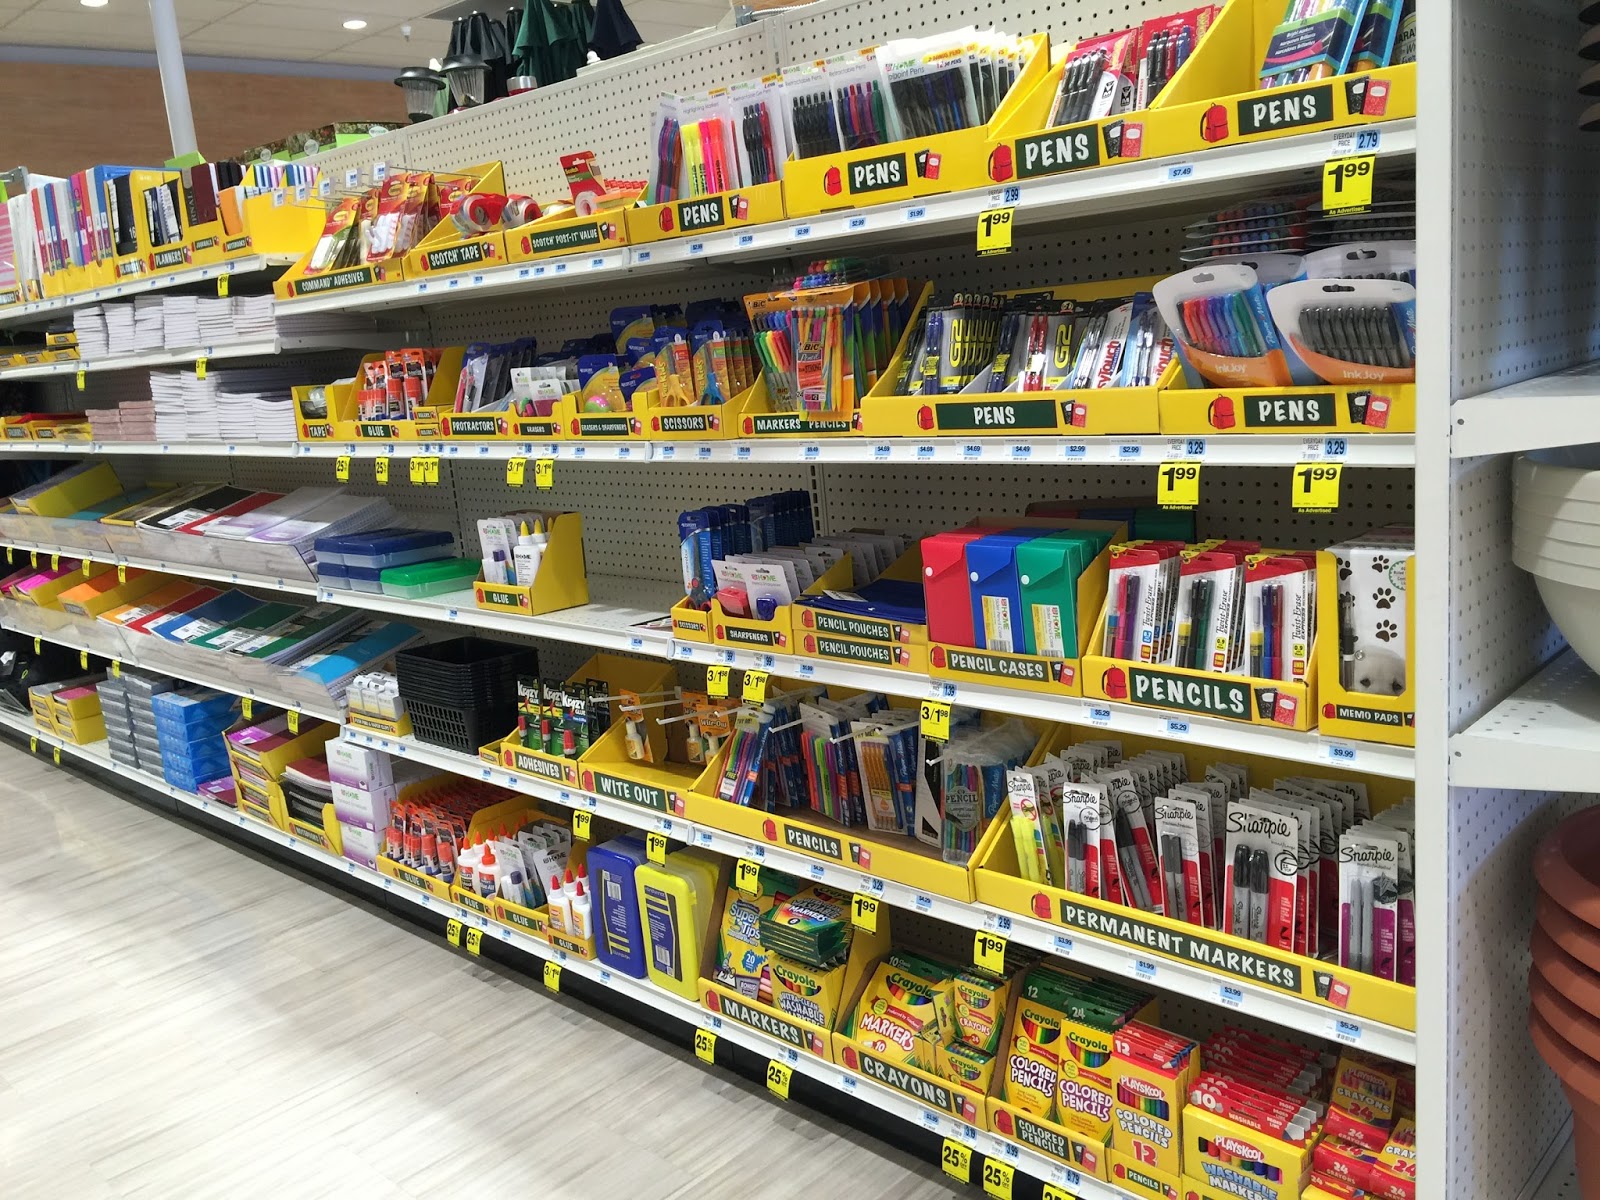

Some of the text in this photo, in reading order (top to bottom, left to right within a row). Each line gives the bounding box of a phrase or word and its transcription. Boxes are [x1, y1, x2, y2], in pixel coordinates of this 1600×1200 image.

[1253, 94, 1317, 128] PENS
[1358, 132, 1378, 149] 2.79
[1024, 134, 1089, 170] PENS
[854, 160, 900, 188] PENS
[1172, 168, 1192, 176] $7.49
[1005, 188, 1019, 202] 2.99
[682, 202, 720, 226] PENS
[579, 228, 598, 241] VALUE
[156, 250, 183, 268] PLANNERS
[460, 246, 480, 260] TAPE
[334, 272, 364, 285] ADHESIVES
[950, 318, 964, 368] G2
[1054, 324, 1072, 368] G2
[1342, 370, 1385, 380] InkJoy
[973, 406, 1016, 425] PENS
[1259, 400, 1320, 422] PENS
[310, 426, 326, 437] TAPE
[367, 426, 385, 437] GLUE
[452, 420, 494, 432] PROTRACTORS
[664, 416, 704, 430] SCISSORS
[756, 418, 800, 430] MARKERS
[1070, 446, 1086, 454] $2.99
[1122, 446, 1140, 454] $2.99
[1187, 440, 1204, 454] 3.29
[1326, 440, 1345, 455] 3.29
[492, 594, 510, 604] GLUE
[818, 616, 890, 638] PENCIL POUCHES
[730, 630, 769, 643] SHARPENERS
[820, 640, 890, 662] PENCIL POUCHES
[950, 653, 1044, 678] PENCIL CASES
[1134, 673, 1245, 714] PENCILS
[1339, 708, 1399, 724] MEMO PADS
[1170, 723, 1187, 732] $5.29
[1334, 748, 1354, 758] $9.99
[518, 754, 560, 778] ADHESIVES
[600, 776, 659, 807] WITE OUT
[1008, 780, 1032, 794] Sharpie
[946, 794, 978, 803] PENCIL
[1064, 790, 1098, 805] Sharpie
[1154, 806, 1194, 820] Sharpie
[1226, 812, 1291, 838] Sharpie
[788, 828, 839, 856] PENCILS
[1339, 848, 1394, 864] Sharpie
[404, 872, 421, 886] GLUE
[464, 896, 479, 910] GLUE
[512, 914, 529, 927] GLUE
[730, 903, 759, 924] Super
[741, 922, 760, 940] Tips
[558, 938, 574, 950] GLUE
[1066, 905, 1294, 988] PERMANENT MARKERS
[746, 954, 755, 964] 20
[890, 956, 898, 967] 10
[1138, 961, 1154, 970] $1.99
[776, 964, 816, 988] Crayola
[890, 972, 932, 998] Crayola
[960, 984, 988, 1000] Crayola
[1028, 985, 1038, 998] 12
[1224, 986, 1241, 996] $3.99
[780, 998, 825, 1025] WASHABLE
[1024, 1008, 1060, 1030] Crayola
[1072, 1006, 1086, 1018] 24
[724, 998, 800, 1045] MARKERS
[960, 1017, 991, 1036] CRAYONS
[1340, 1021, 1359, 1032] $5.29
[861, 1013, 914, 1052] MARKERS
[875, 1040, 886, 1052] 10
[1069, 1032, 1109, 1052] Crayola
[1115, 1040, 1130, 1056] 12
[950, 1056, 978, 1072] Crayola
[1010, 1055, 1058, 1083] COLORED
[864, 1057, 948, 1108] CRAYONS
[1010, 1068, 1054, 1098] PENCILS
[1120, 1076, 1164, 1100] PLAYSKOOL
[1060, 1080, 1114, 1108] COLORED
[1193, 1090, 1216, 1108] 10
[1336, 1087, 1391, 1114] CRAYONS
[1062, 1092, 1110, 1122] PENCILS
[1348, 1102, 1374, 1122] 24
[1116, 1108, 1172, 1139] COLORED
[1229, 1112, 1262, 1130] WASHABLE
[1018, 1120, 1065, 1146] COLORED
[1120, 1122, 1169, 1149] PENCILS
[1349, 1128, 1364, 1140] 24
[1022, 1132, 1064, 1158] PENCILS
[1133, 1140, 1158, 1168] 12
[1214, 1134, 1264, 1163] PLAYSKOOL
[1334, 1162, 1348, 1174] 24
[1128, 1170, 1159, 1190] PENCILS
[1202, 1162, 1278, 1200] WASHABLE
[1311, 1176, 1323, 1186] 24
[1390, 1186, 1406, 1198] 24
